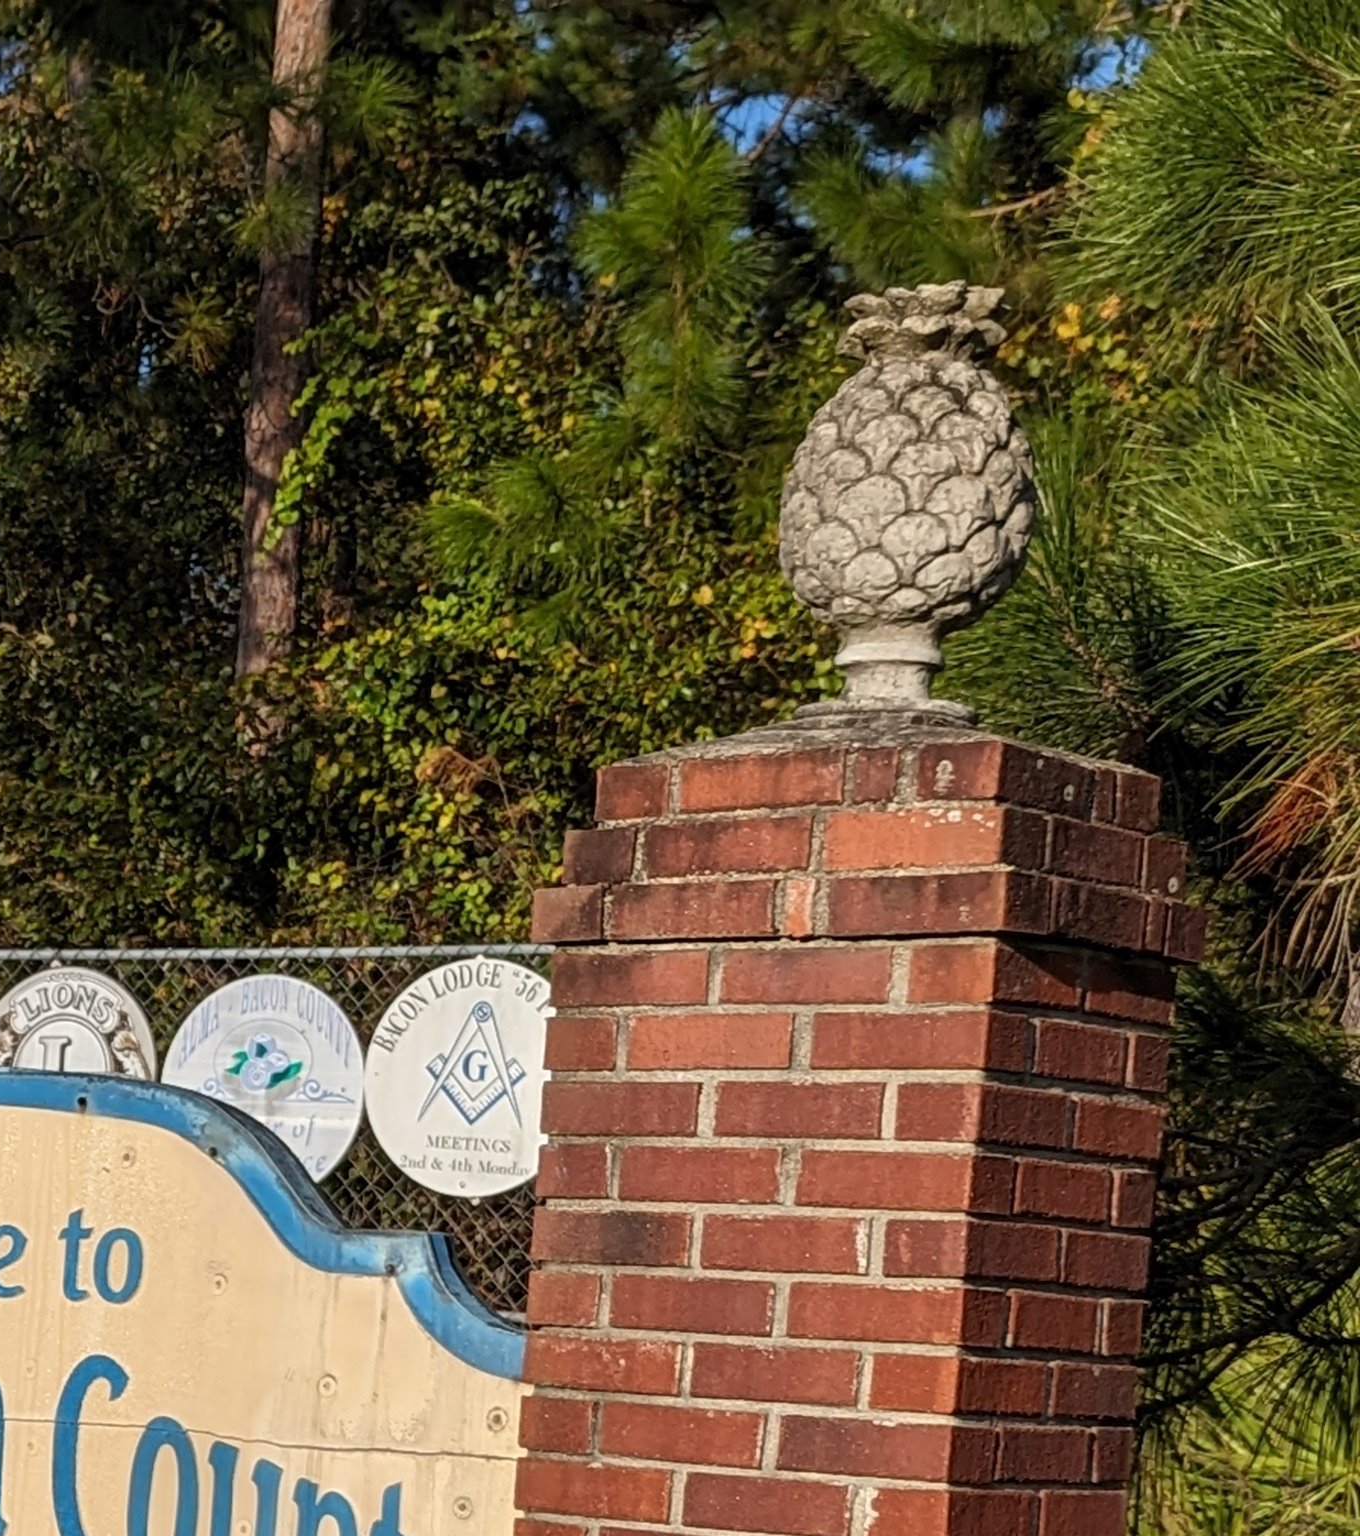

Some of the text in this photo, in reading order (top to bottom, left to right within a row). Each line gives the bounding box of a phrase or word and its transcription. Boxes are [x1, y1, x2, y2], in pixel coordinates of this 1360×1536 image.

[18, 983, 115, 1023] LIONS
[373, 988, 429, 1053] BACON
[428, 961, 504, 999] LODGE
[240, 978, 290, 1015] BACON
[297, 985, 353, 1069] COUNTY
[462, 1050, 488, 1082] G
[400, 1154, 426, 1170] 2nd
[431, 1158, 442, 1171] &
[448, 1157, 472, 1173] 4th
[426, 1134, 511, 1153] MEETINGS
[59, 1208, 144, 1304] to
